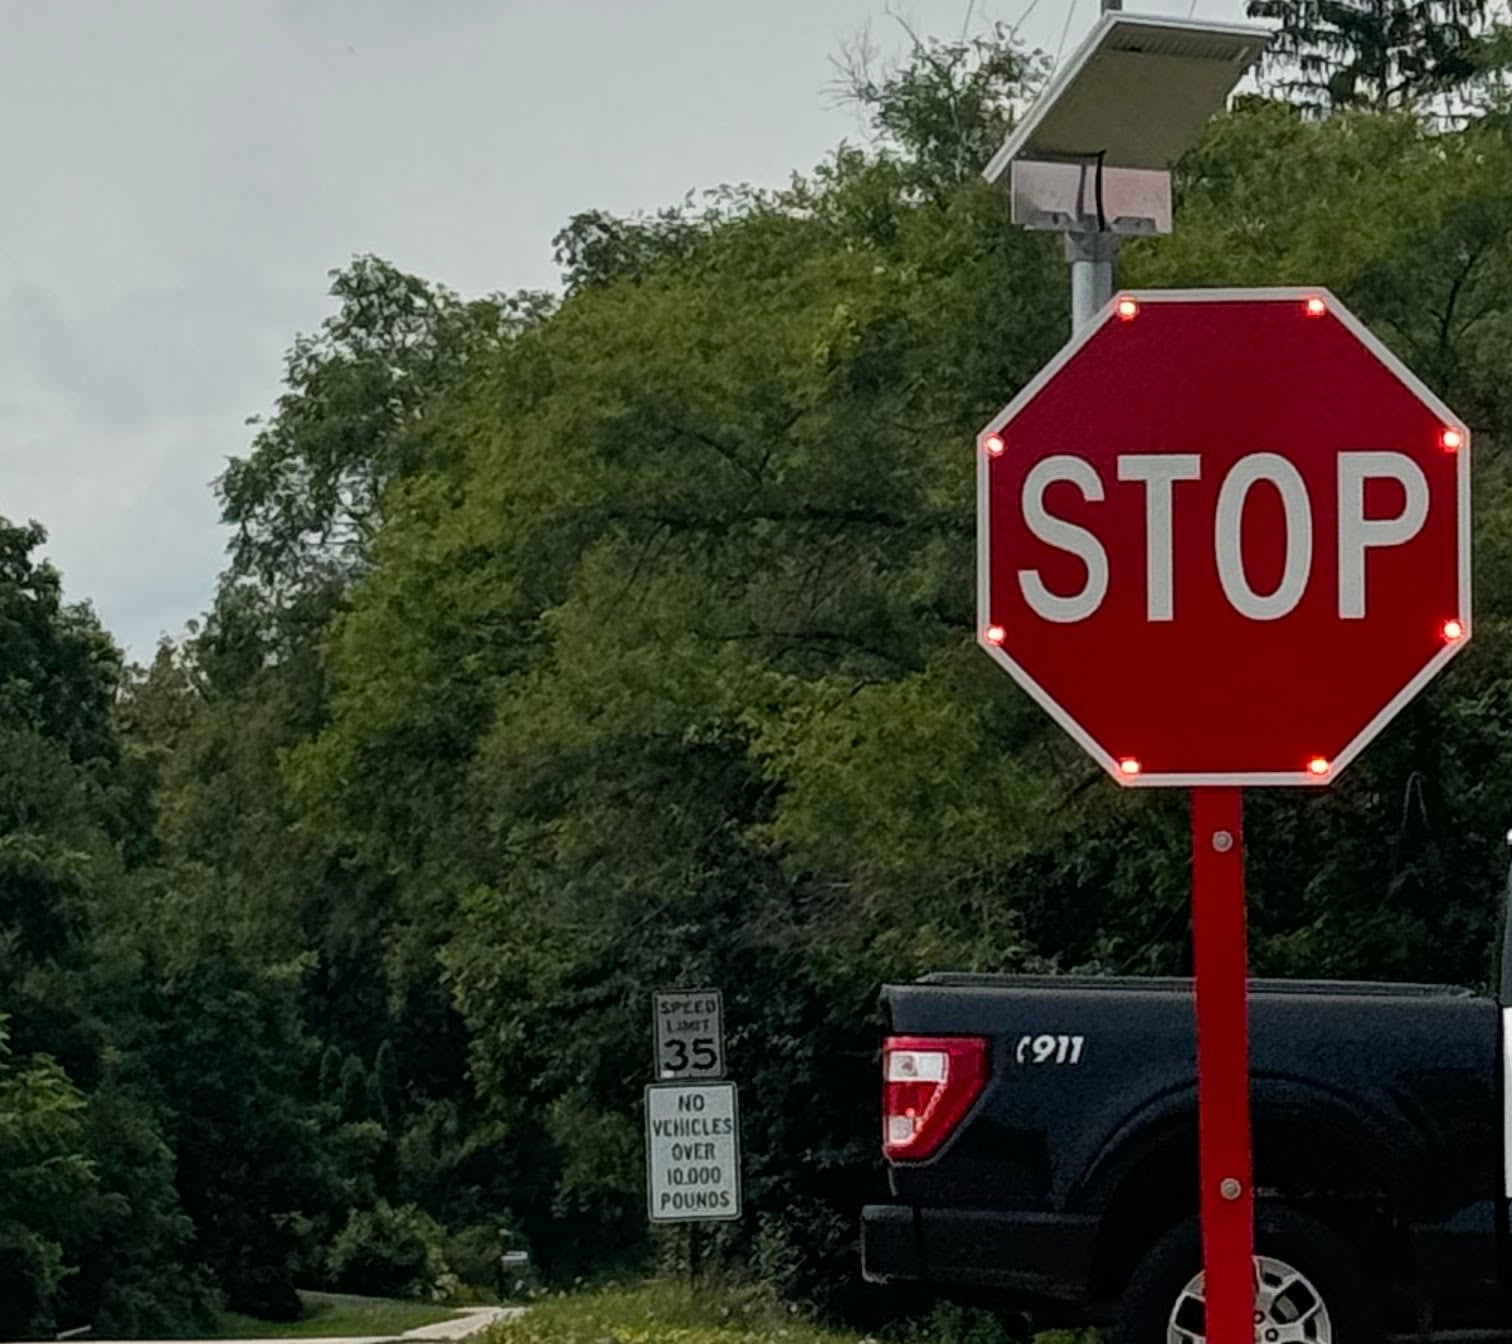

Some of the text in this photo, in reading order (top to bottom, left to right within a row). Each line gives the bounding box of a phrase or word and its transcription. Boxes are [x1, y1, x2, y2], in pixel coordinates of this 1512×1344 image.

[1017, 451, 1430, 624] STOP
[660, 1000, 717, 1015] SPEED
[666, 1019, 710, 1033] LIMIT
[664, 1039, 717, 1071] 35
[1032, 1035, 1085, 1064] 911
[678, 1094, 705, 1112] NO
[653, 1118, 732, 1137] VEHICLES
[672, 1143, 716, 1161] OVER
[661, 1190, 730, 1210] POUNDS
